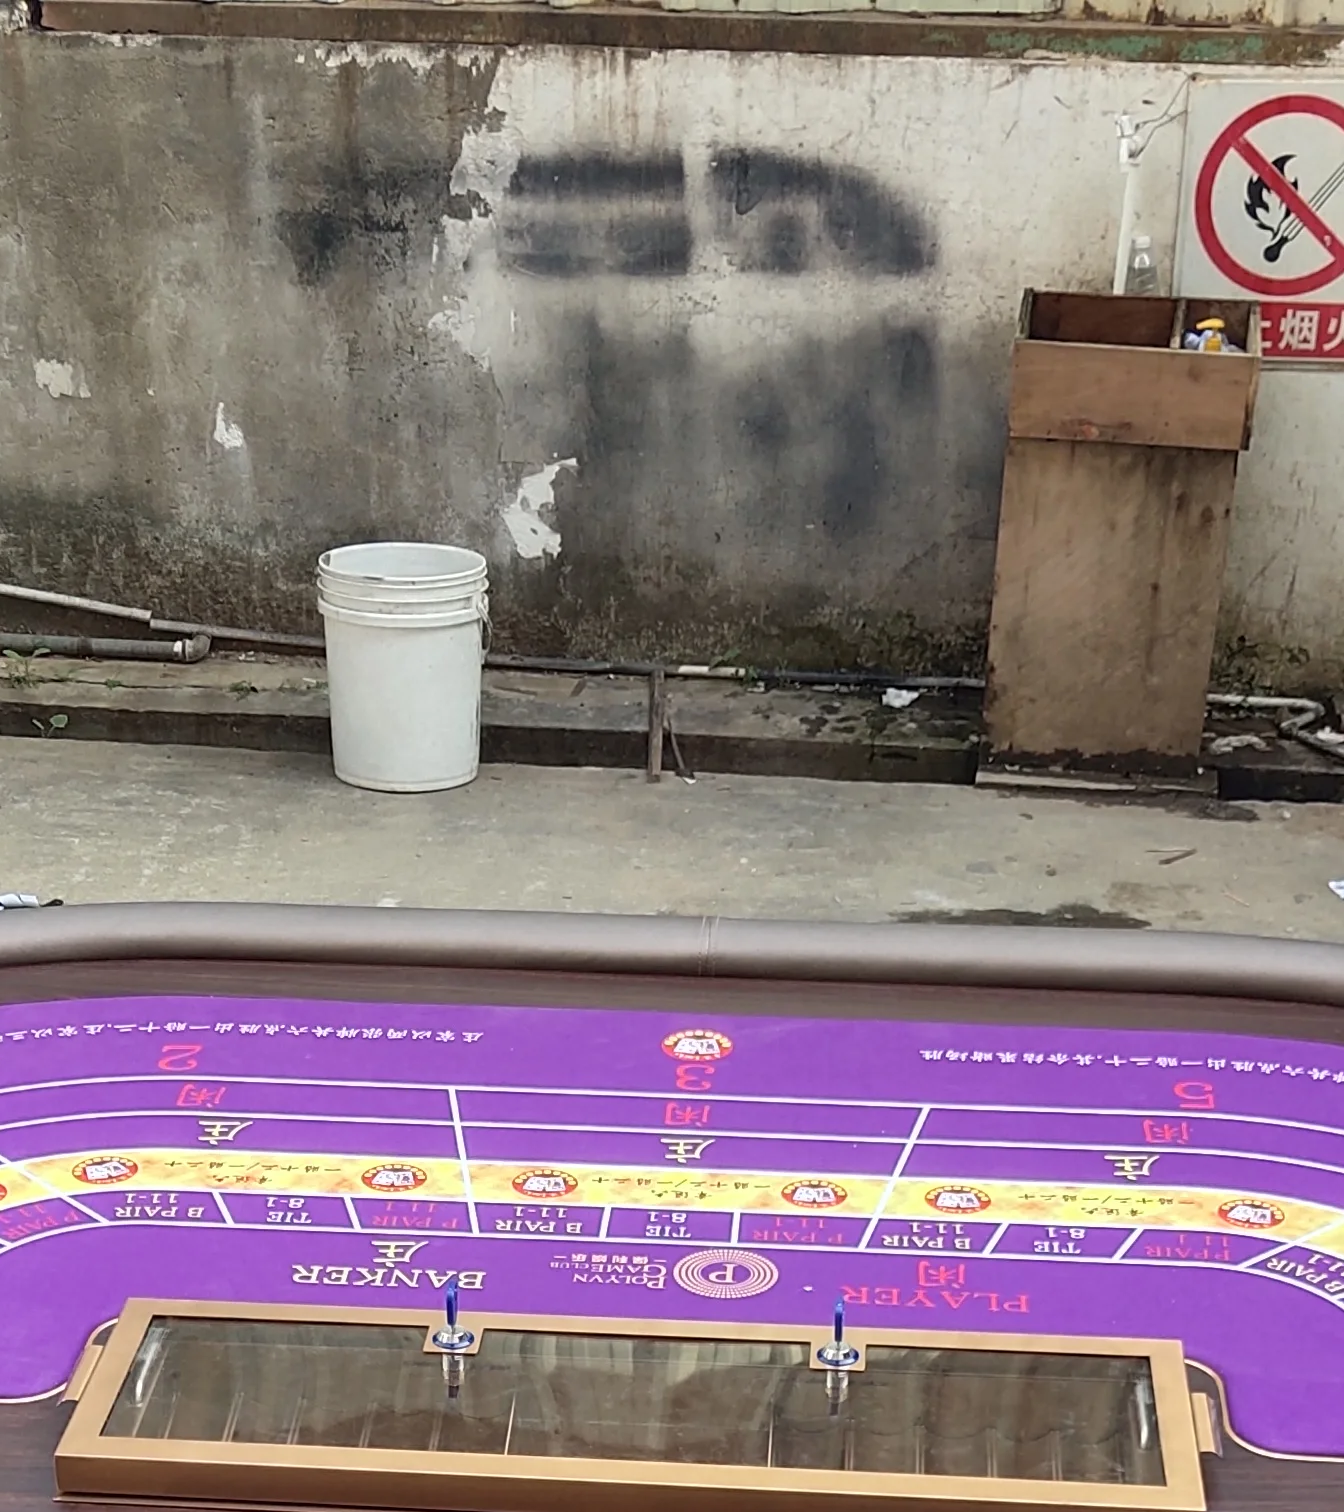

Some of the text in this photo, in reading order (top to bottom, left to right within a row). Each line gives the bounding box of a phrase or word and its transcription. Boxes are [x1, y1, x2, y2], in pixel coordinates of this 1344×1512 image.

[158, 1044, 202, 1071] 2
[676, 1064, 715, 1090] 3
[176, 1083, 228, 1108] 闲
[1173, 1082, 1215, 1109] 5
[664, 1102, 710, 1127] 闲
[198, 1119, 253, 1146] 庄
[1142, 1119, 1191, 1144] 闲
[660, 1138, 715, 1163] 庄
[1103, 1154, 1160, 1181] 庄
[124, 1192, 179, 1204] 11-1
[265, 1197, 304, 1208] 8-1
[265, 1210, 312, 1224] TIE
[513, 1206, 567, 1218] 11-1
[648, 1211, 687, 1223] 8-1
[645, 1225, 691, 1238] TIE
[909, 1222, 964, 1235] 11-1
[1045, 1226, 1086, 1239] 8-1
[371, 1240, 429, 1266] 庄
[1034, 1240, 1080, 1254] TIE
[292, 1264, 486, 1290] BANKER
[709, 1263, 737, 1283] P
[916, 1261, 965, 1288] 闲
[842, 1284, 1030, 1314] PLAYER
